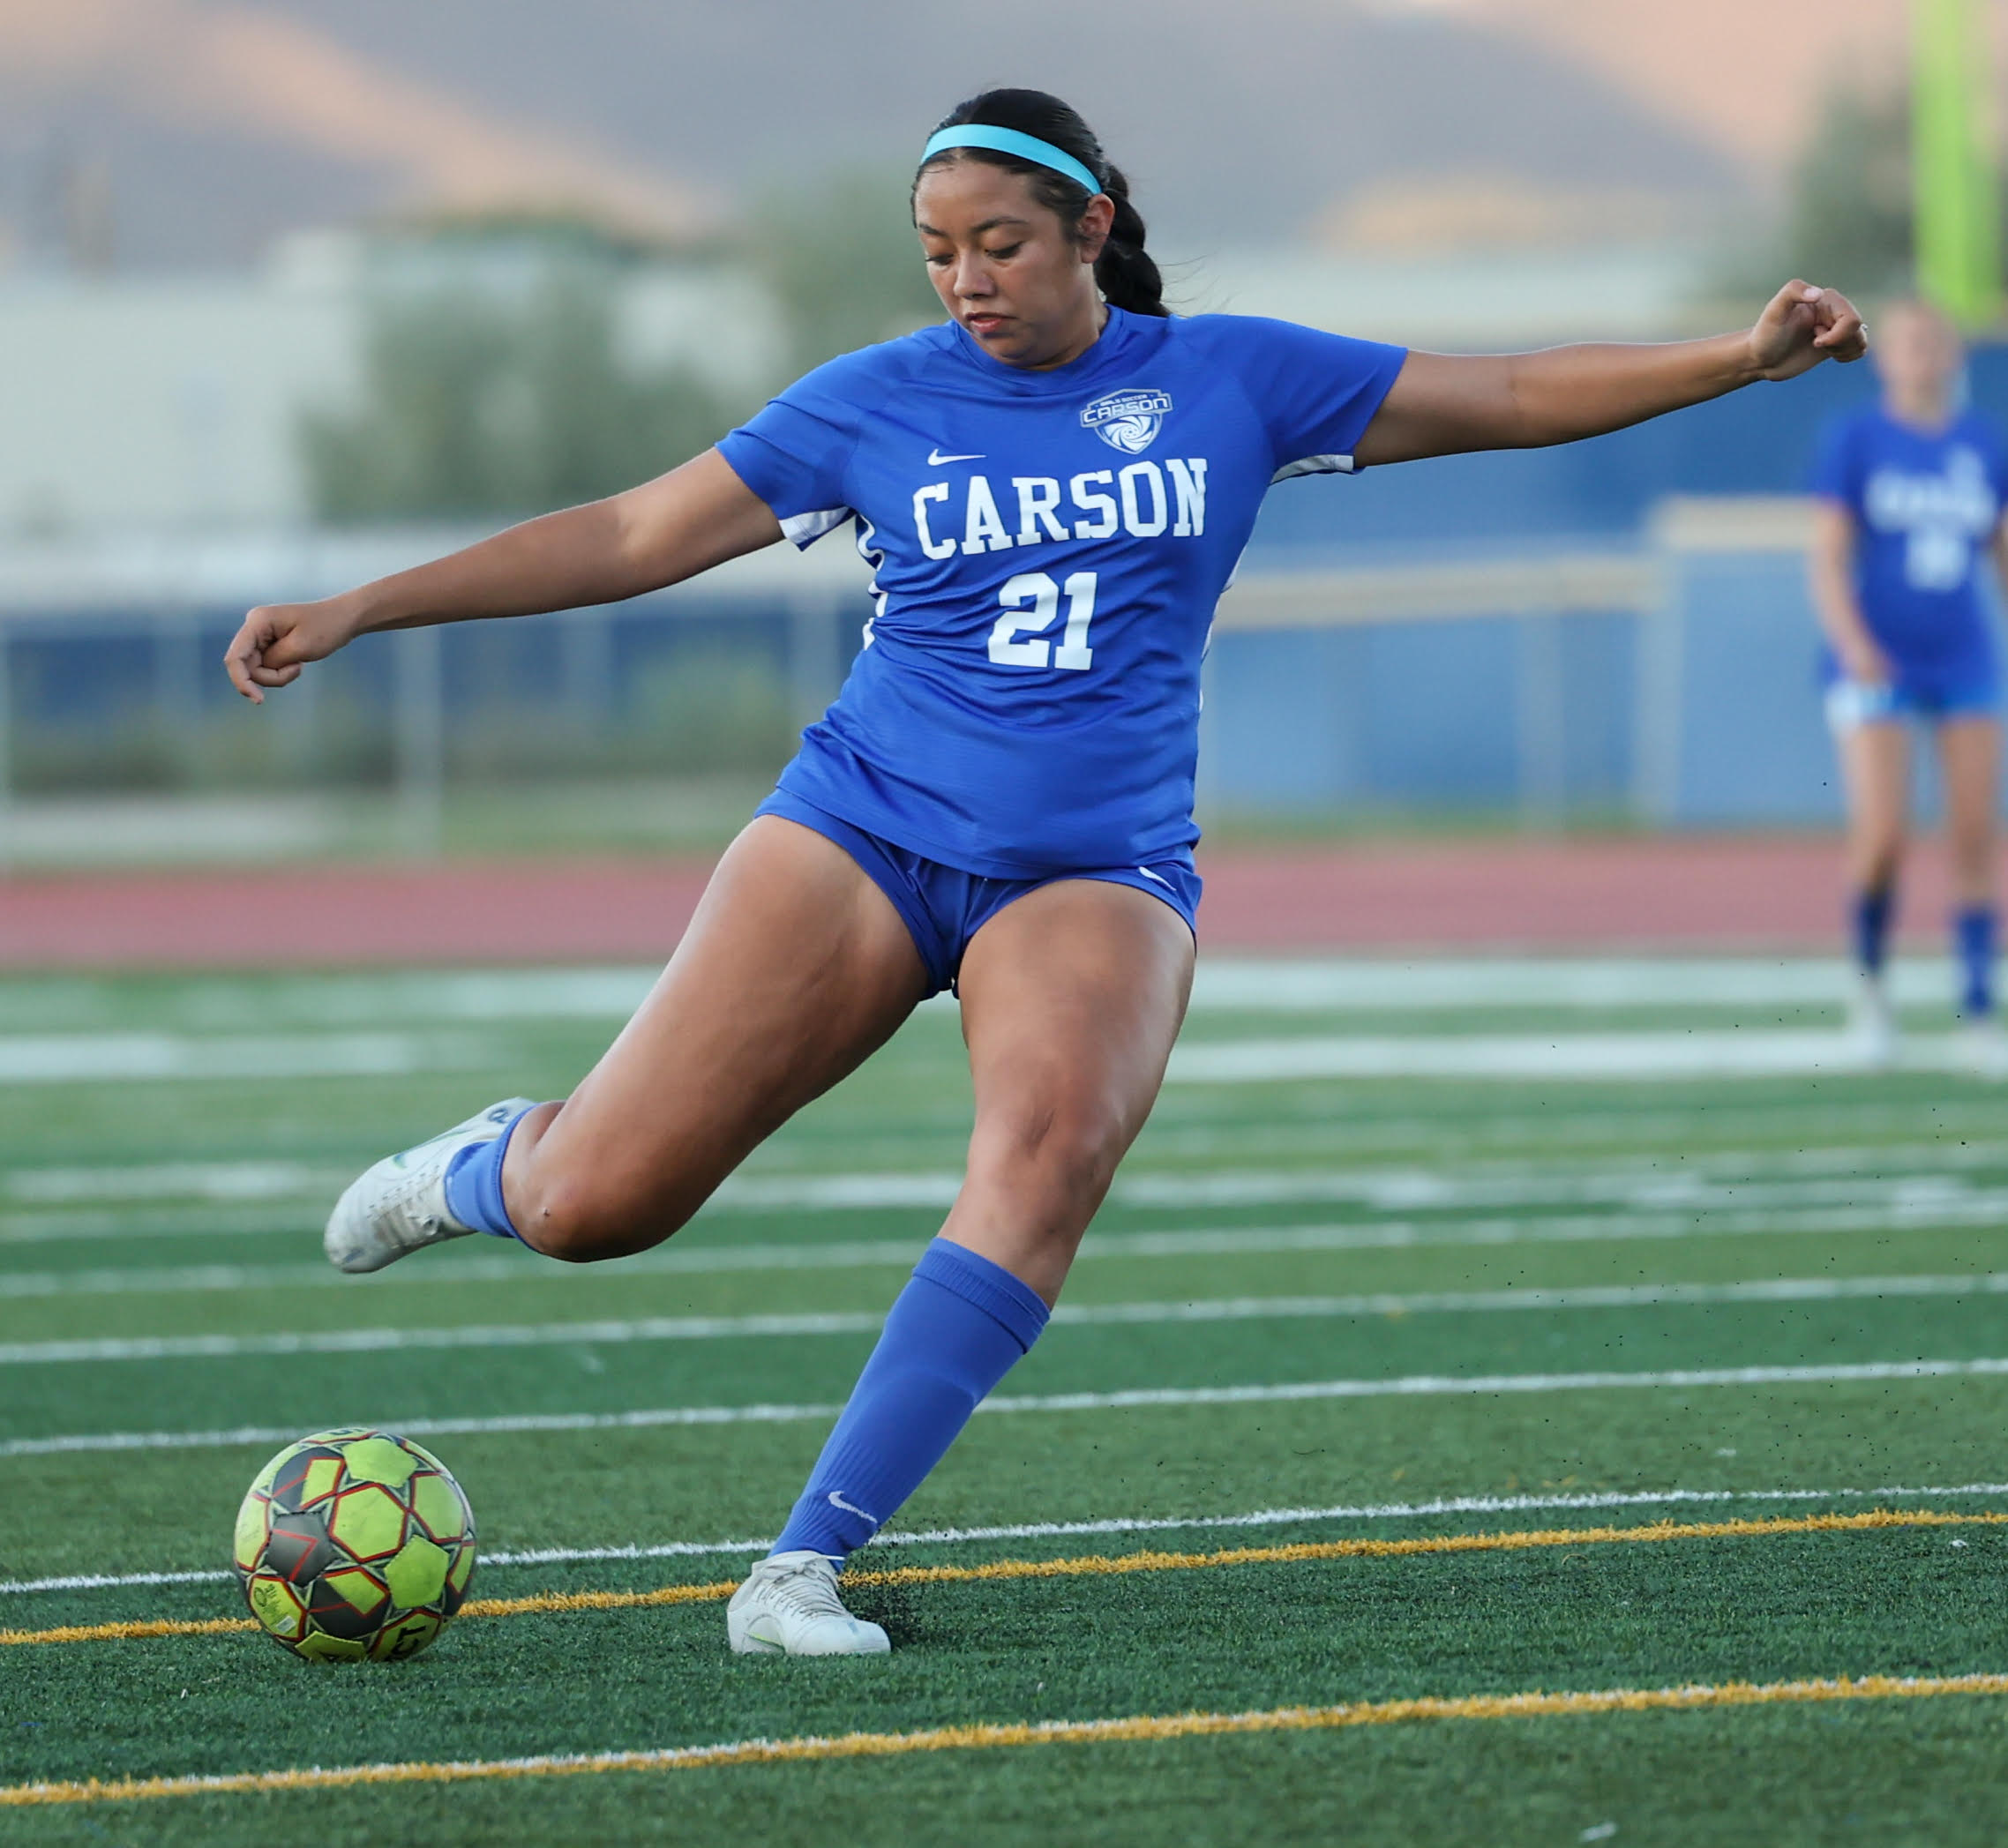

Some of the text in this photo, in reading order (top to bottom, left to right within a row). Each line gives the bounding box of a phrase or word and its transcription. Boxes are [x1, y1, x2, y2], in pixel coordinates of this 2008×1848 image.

[1083, 397, 1169, 423] CARSON
[912, 458, 1208, 560] CARSON
[988, 572, 1098, 670] 21
